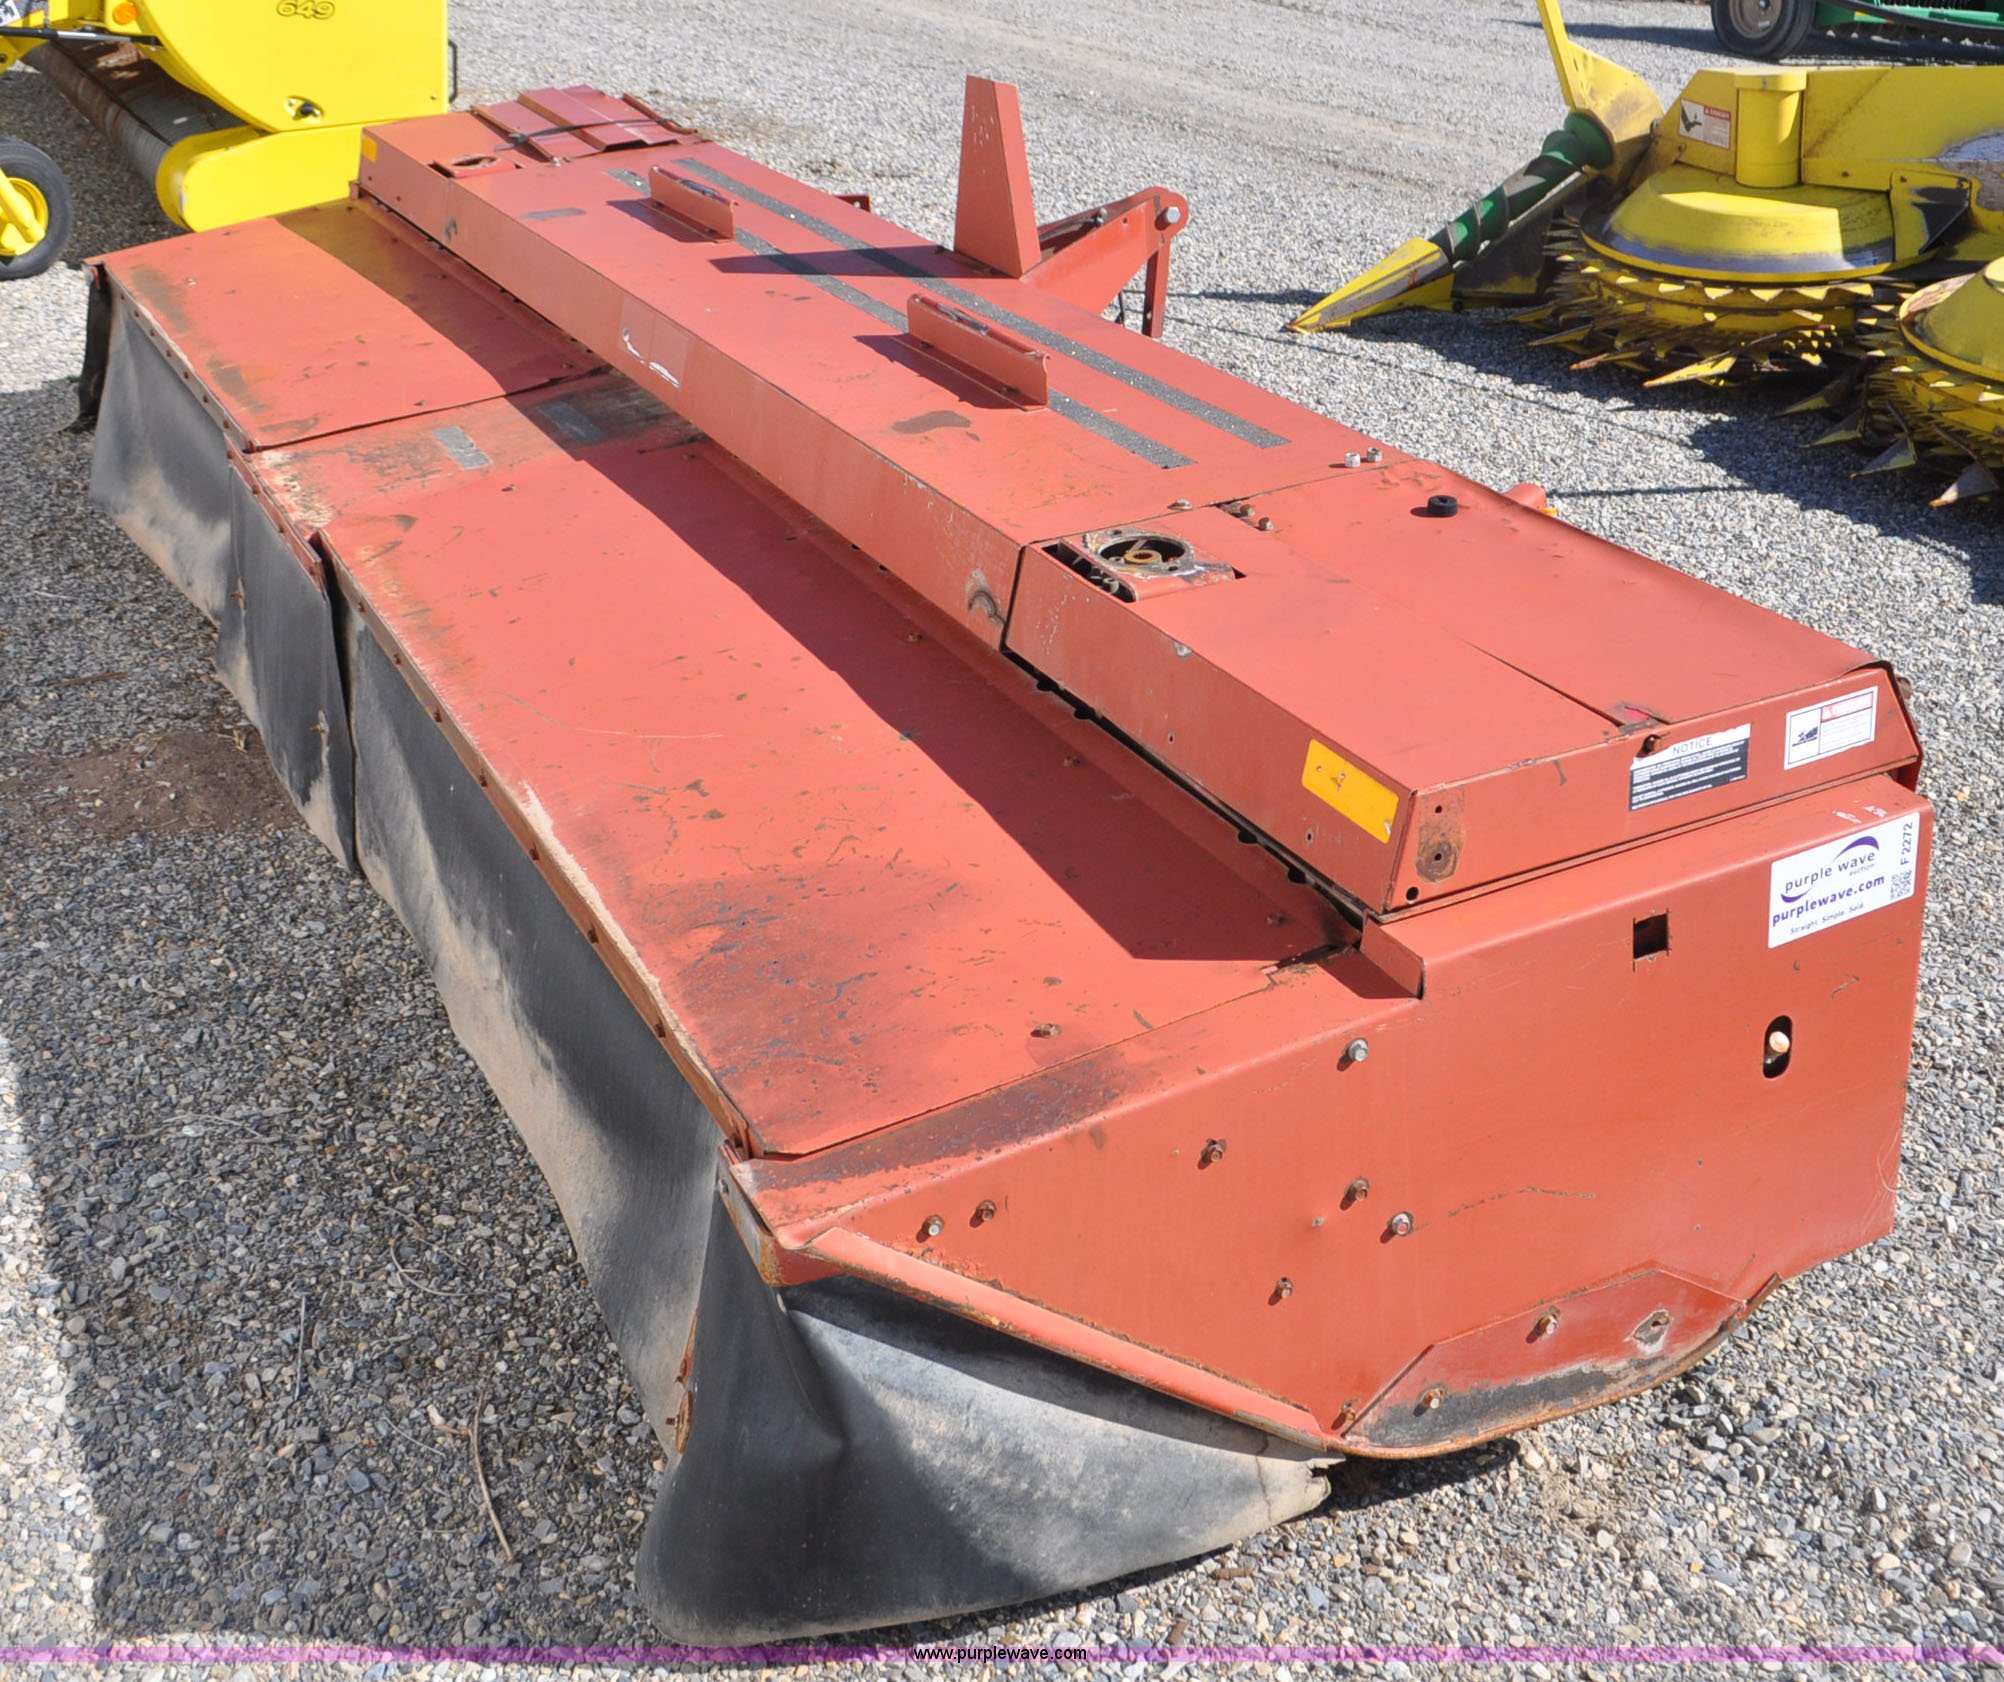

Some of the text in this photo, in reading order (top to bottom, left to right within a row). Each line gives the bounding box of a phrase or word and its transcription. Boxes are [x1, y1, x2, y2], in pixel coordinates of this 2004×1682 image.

[276, 0, 335, 20] 649
[1672, 736, 1713, 755] NOTICE
[1900, 822, 1913, 865] F 2272
[1785, 851, 1876, 893] purple wave
[1772, 875, 1886, 927] purplewave.com
